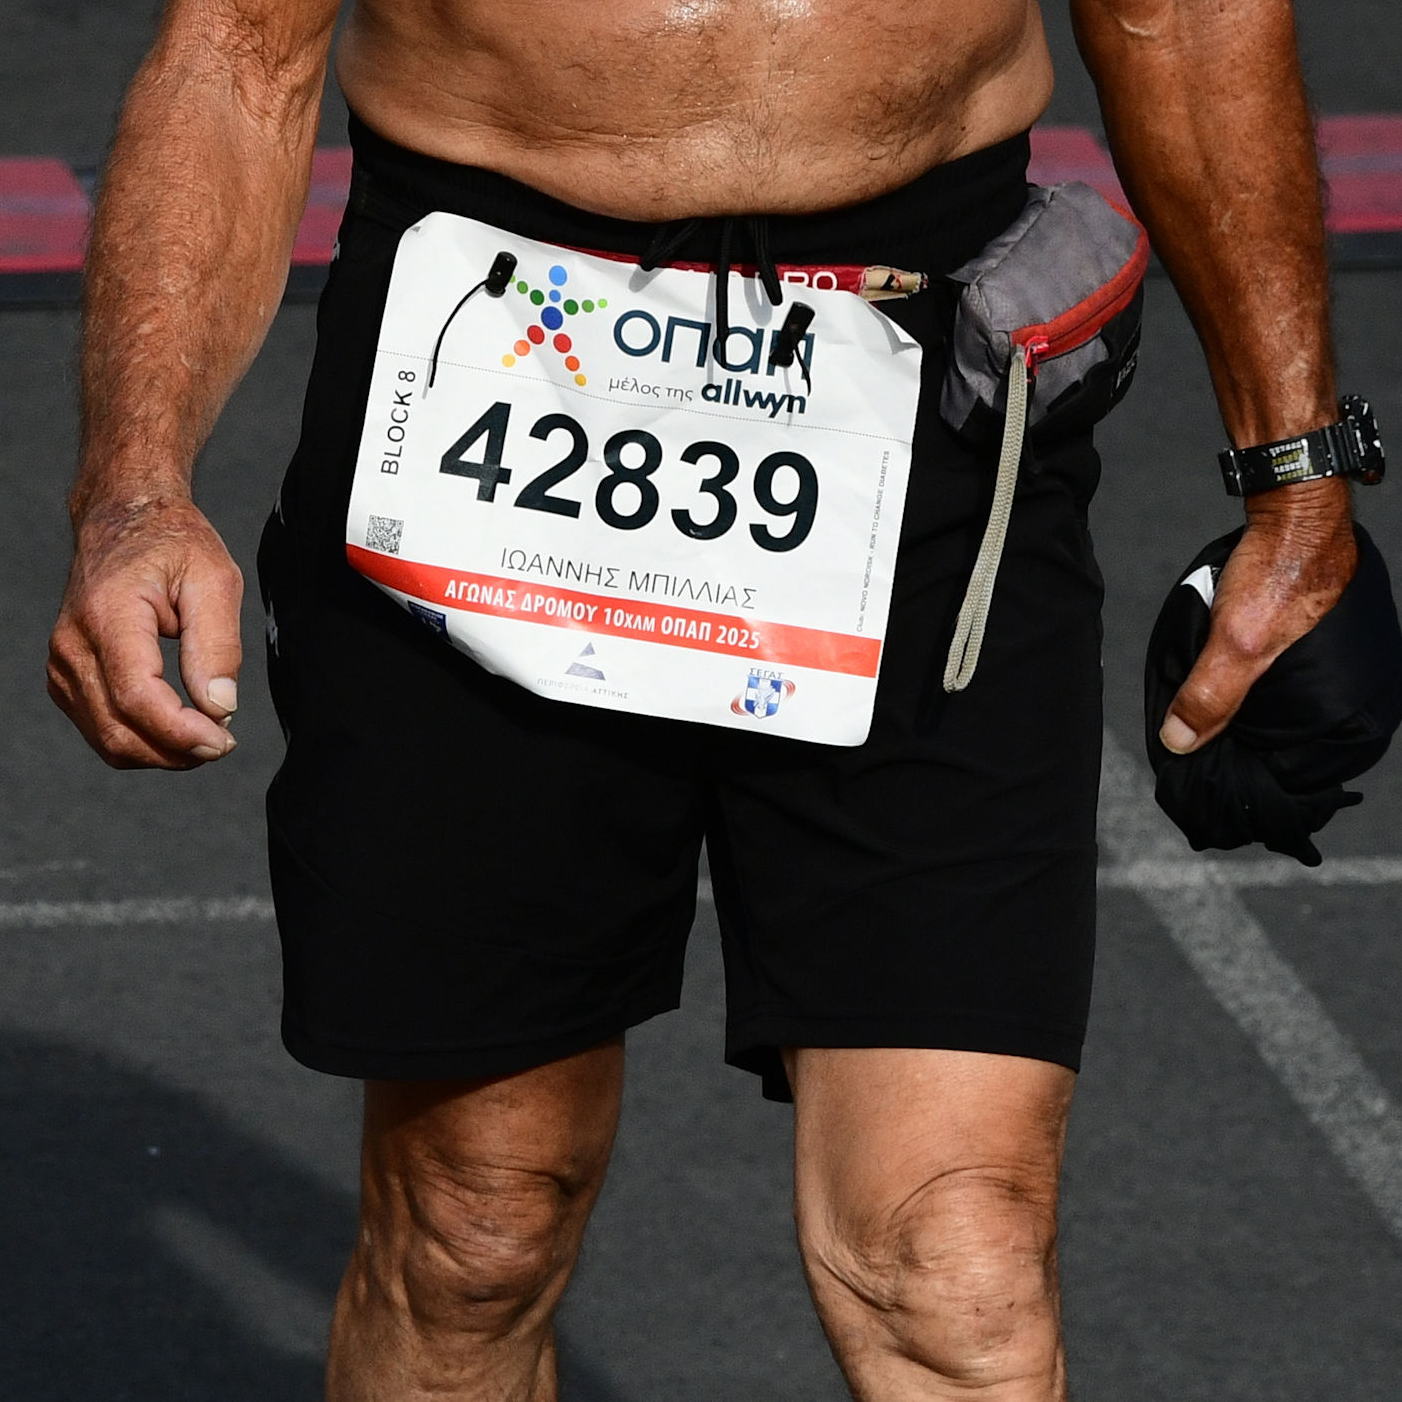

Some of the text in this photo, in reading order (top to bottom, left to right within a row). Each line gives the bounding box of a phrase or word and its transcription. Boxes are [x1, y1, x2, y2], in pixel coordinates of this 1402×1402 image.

[608, 377, 807, 418] μέλος της allwyn
[380, 370, 416, 475] BLOCK 8
[439, 401, 820, 553] 42839
[878, 450, 890, 487] DIABETES
[873, 489, 884, 521] CHANGE
[871, 521, 879, 534] TO
[500, 547, 758, 610] ΙΩΑΝΝΗΣ ΜΠΙΛΛΙΑΣ
[444, 579, 517, 609] ΑΓΩΝΑΣ
[520, 593, 599, 623] ΔΡΟΜΟΥ
[660, 615, 712, 642] ΟΠΑΠ
[715, 625, 761, 650] 2025
[859, 589, 869, 612] NOVO
[749, 667, 785, 680] ΣΕΓΑΣ
